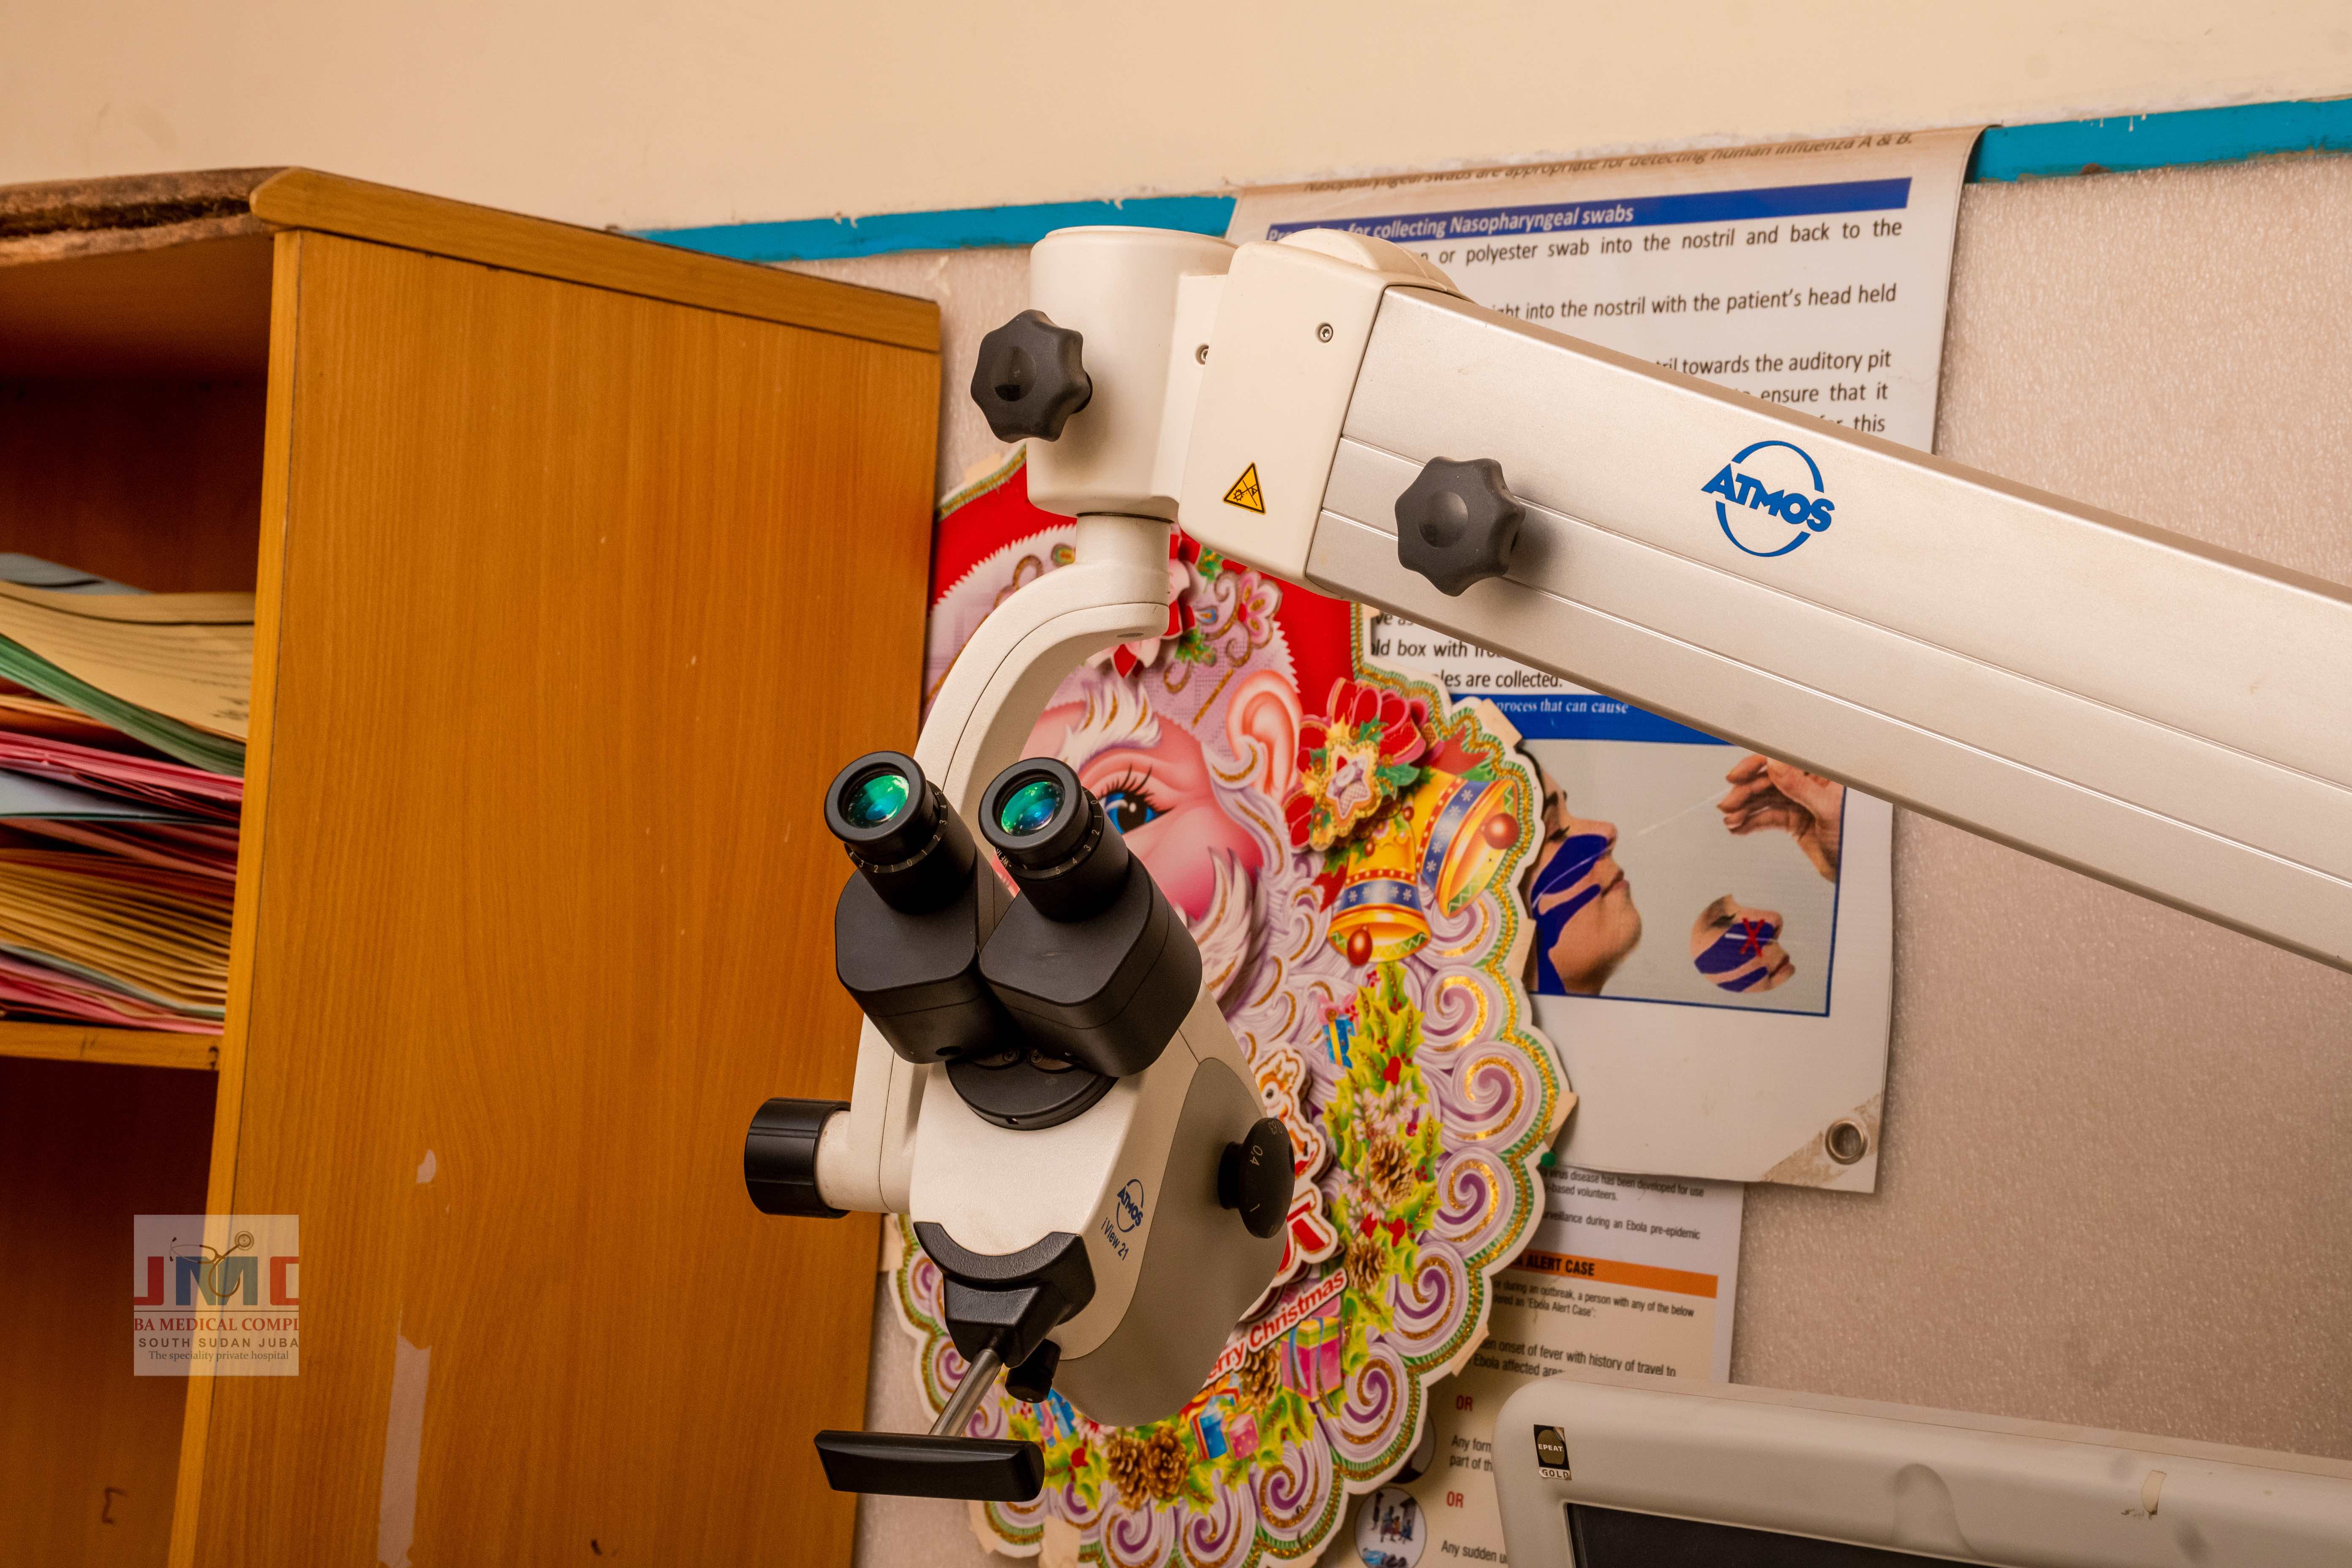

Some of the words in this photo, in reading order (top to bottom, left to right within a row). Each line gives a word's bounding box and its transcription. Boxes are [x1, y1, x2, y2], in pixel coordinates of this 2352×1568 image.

[1711, 144, 1772, 161] human
[1857, 135, 1873, 148] A
[1876, 134, 1895, 147] &
[1373, 218, 1445, 239] collecting
[1450, 207, 1579, 235] Nasopharyngeal
[1582, 205, 1634, 224] swabs
[1439, 251, 1456, 264] or
[1466, 242, 1537, 267] polyester
[1548, 238, 1590, 255] swab
[1600, 236, 1632, 254] into
[1643, 233, 1671, 252] the
[1682, 228, 1736, 249] nostril
[1746, 224, 1778, 245] and
[1791, 222, 1829, 243] back
[1842, 222, 1860, 239] to
[1873, 219, 1902, 238] the
[1526, 301, 1555, 319] into
[1561, 299, 1587, 317] the
[1594, 296, 1645, 317] nostril
[1652, 294, 1686, 315] with
[1693, 292, 1720, 313] the
[1726, 288, 1801, 314] patient's
[1808, 284, 1851, 305] head
[1858, 283, 1896, 303] held
[1682, 355, 1749, 374] towards
[1756, 354, 1783, 371] the
[1789, 351, 1862, 372] auditory
[1868, 349, 1891, 372] pit
[1761, 388, 1819, 403] ensure
[1830, 384, 1866, 400] that
[1876, 382, 1889, 399] it
[1854, 414, 1885, 433] this
[1701, 463, 1835, 532] ATMOS
[1398, 640, 1426, 656] box
[1434, 640, 1467, 657] with
[1441, 670, 1461, 688] les
[1466, 674, 1490, 687] are
[1541, 697, 1562, 712] that
[1566, 701, 1587, 712] can
[1591, 701, 1628, 714] cause
[1571, 1170, 1599, 1183] disease
[1602, 1173, 1614, 1185] has
[1617, 1176, 1635, 1187] been
[1637, 1179, 1676, 1195] developed
[1678, 1184, 1688, 1195] for
[1690, 1187, 1704, 1198] use
[1577, 1187, 1617, 1201] volunteers.
[1117, 1186, 1143, 1226] ATMOS
[1586, 1215, 1610, 1229] during
[1613, 1220, 1623, 1228] an
[1626, 1220, 1647, 1232] Ebola
[1650, 1224, 1701, 1240] pre-epidemic
[1118, 1243, 1129, 1260] 21
[1526, 1254, 1561, 1271] ALERT
[1565, 1260, 1595, 1277] CASE
[1529, 1285, 1539, 1293] an
[1540, 1286, 1575, 1301] outbreak,
[1578, 1293, 1583, 1301] a
[1584, 1293, 1611, 1306] person
[1613, 1296, 1629, 1308] with
[1631, 1300, 1644, 1312] any
[1647, 1301, 1655, 1312] of
[1657, 1302, 1669, 1313] the
[1671, 1304, 1694, 1317] below
[1552, 1301, 1571, 1314] Alert
[1208, 1342, 1244, 1379] erry
[1250, 1271, 1344, 1348] Christmas
[1473, 1353, 1499, 1370] Ebola
[1502, 1358, 1540, 1376] affected
[1499, 1340, 1524, 1356] onset
[1527, 1343, 1538, 1357] of
[1540, 1345, 1563, 1361] fever
[1566, 1350, 1586, 1364] with
[1589, 1353, 1622, 1371] history
[1625, 1359, 1635, 1372] of
[1637, 1361, 1663, 1376] travel
[1666, 1366, 1676, 1377] to
[1456, 1395, 1473, 1412] OR
[1451, 1435, 1470, 1451] Any
[1538, 1444, 1563, 1452] EPEAT
[1450, 1455, 1469, 1468] part
[1472, 1458, 1481, 1470] of
[1484, 1459, 1493, 1472] th
[1542, 1469, 1568, 1478] GOLD
[1447, 1491, 1464, 1508] OR
[1441, 1540, 1460, 1557] Any
[1462, 1546, 1497, 1562] sudden
